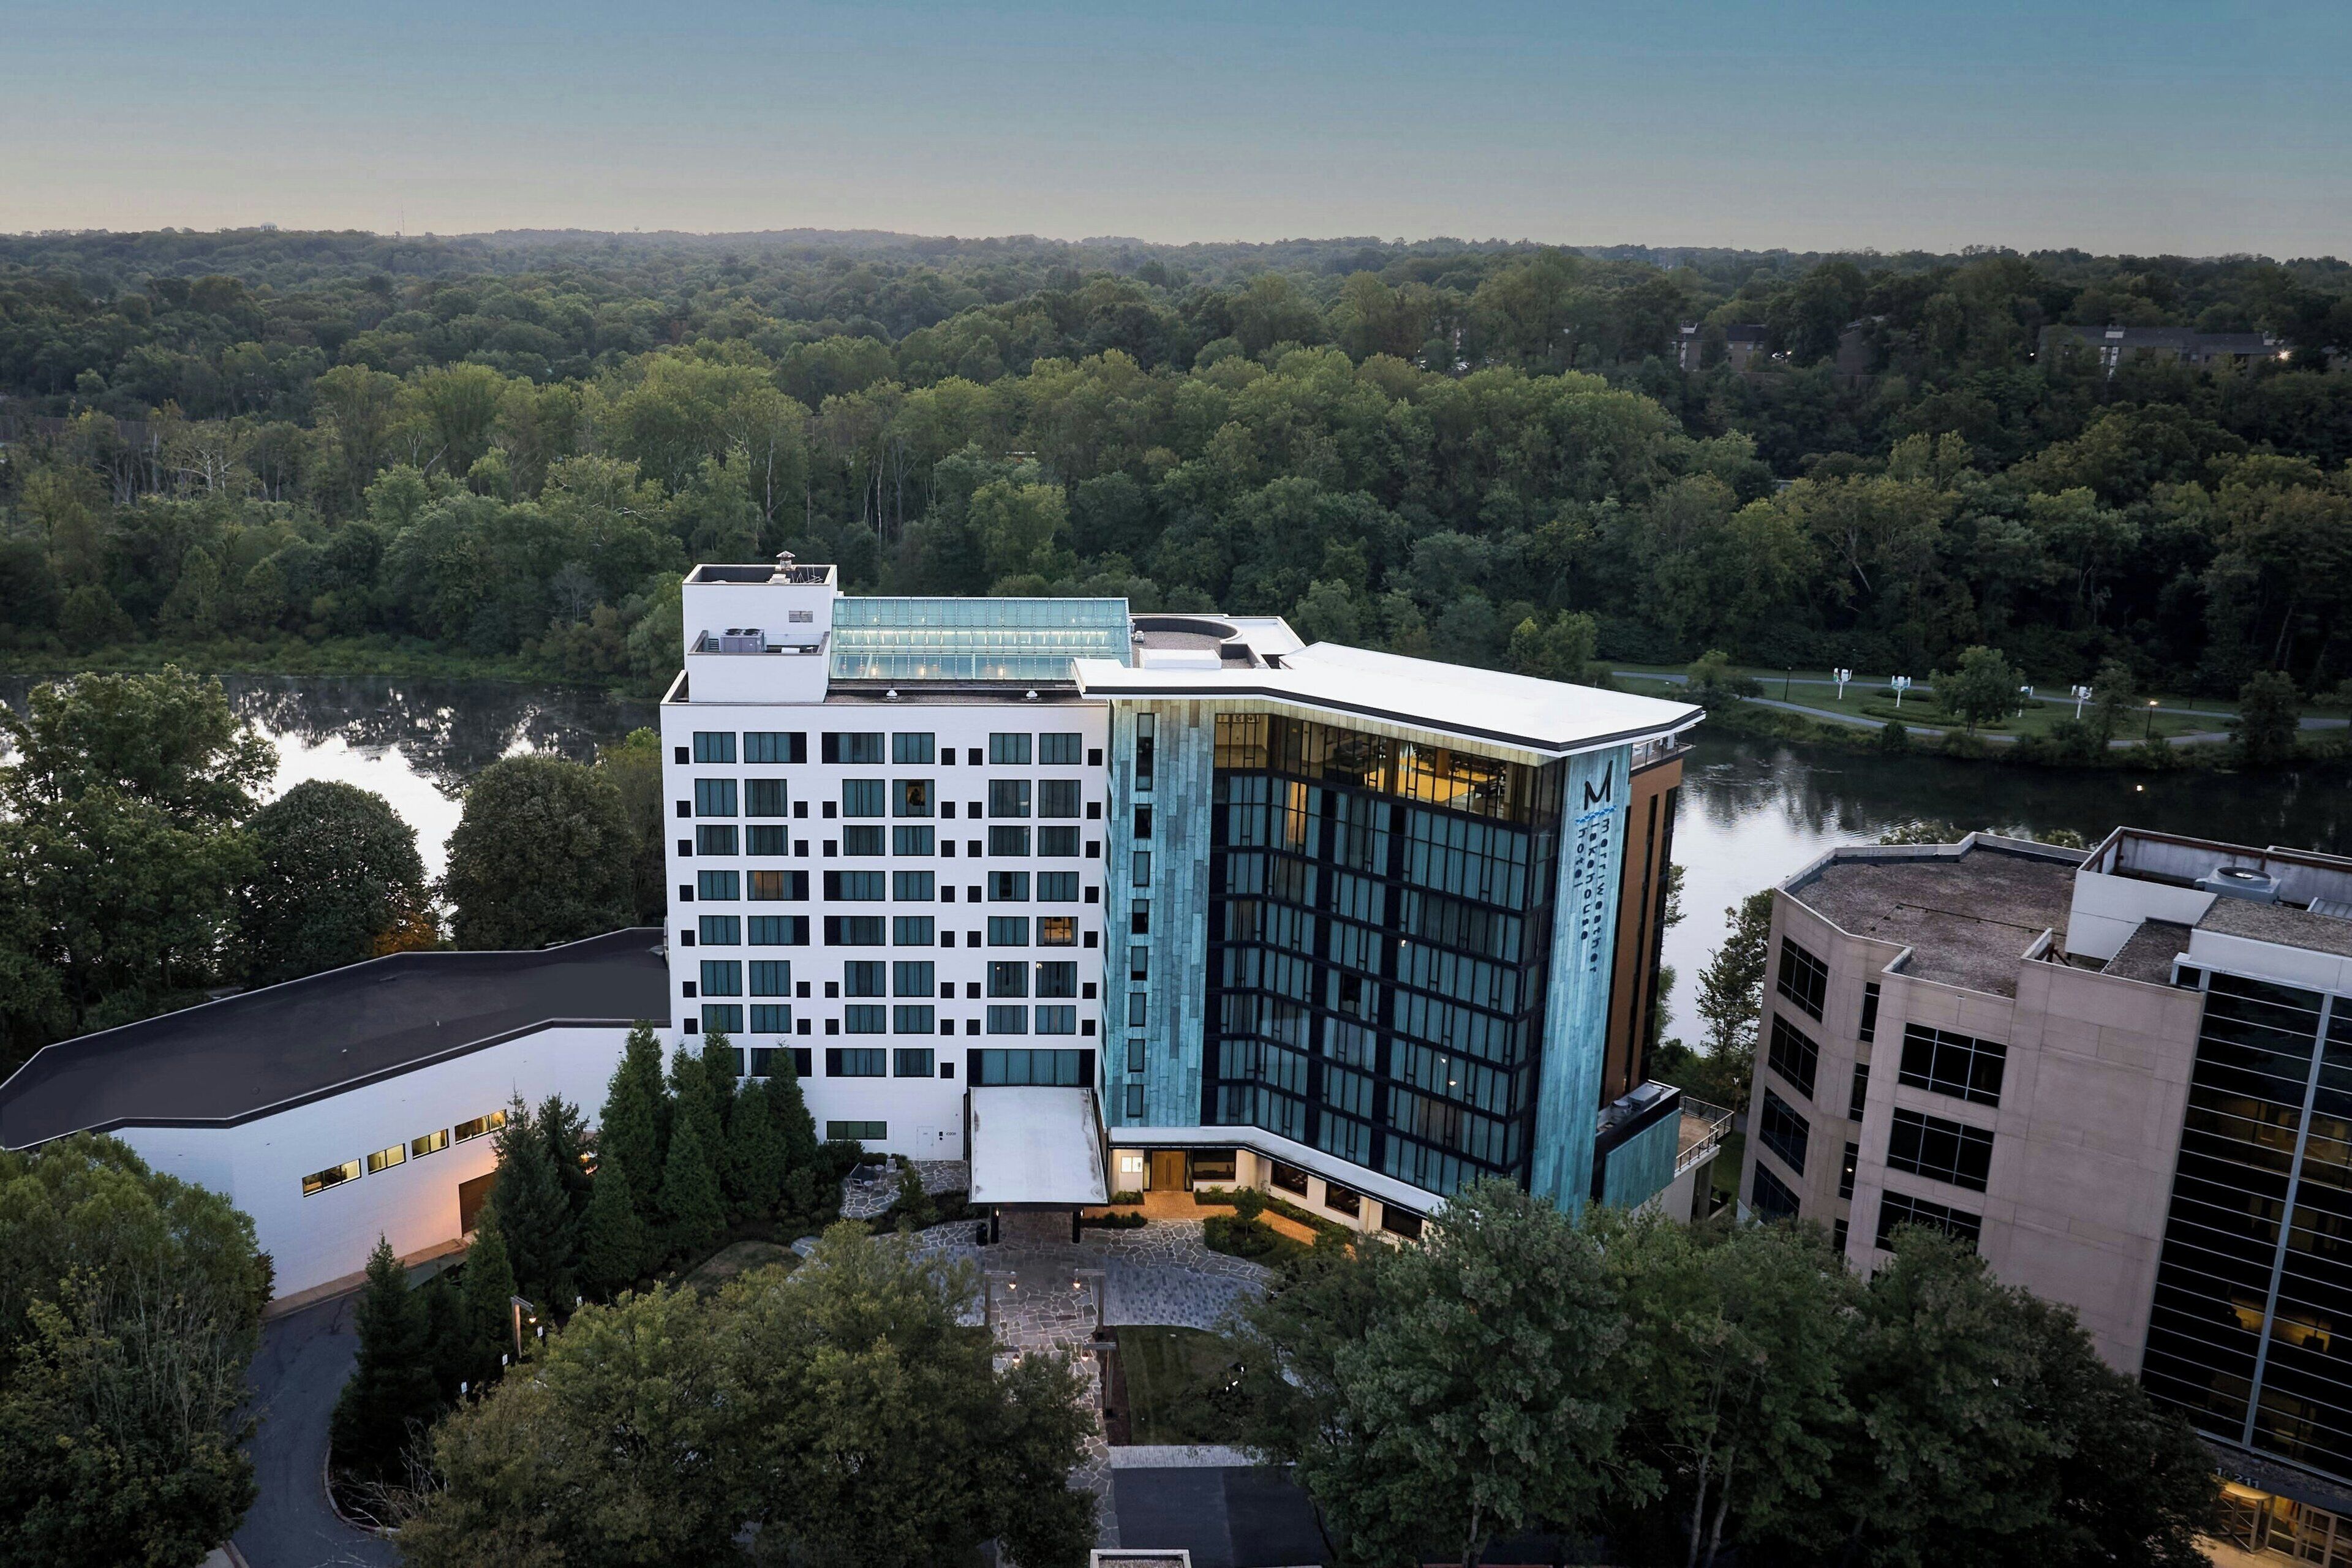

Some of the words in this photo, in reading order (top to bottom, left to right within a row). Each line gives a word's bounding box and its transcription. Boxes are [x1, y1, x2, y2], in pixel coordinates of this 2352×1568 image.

[1584, 760, 1613, 810] M
[1574, 827, 1588, 888] hotel
[1581, 823, 1600, 940] lakehouse
[1589, 818, 1610, 973] merriweather
